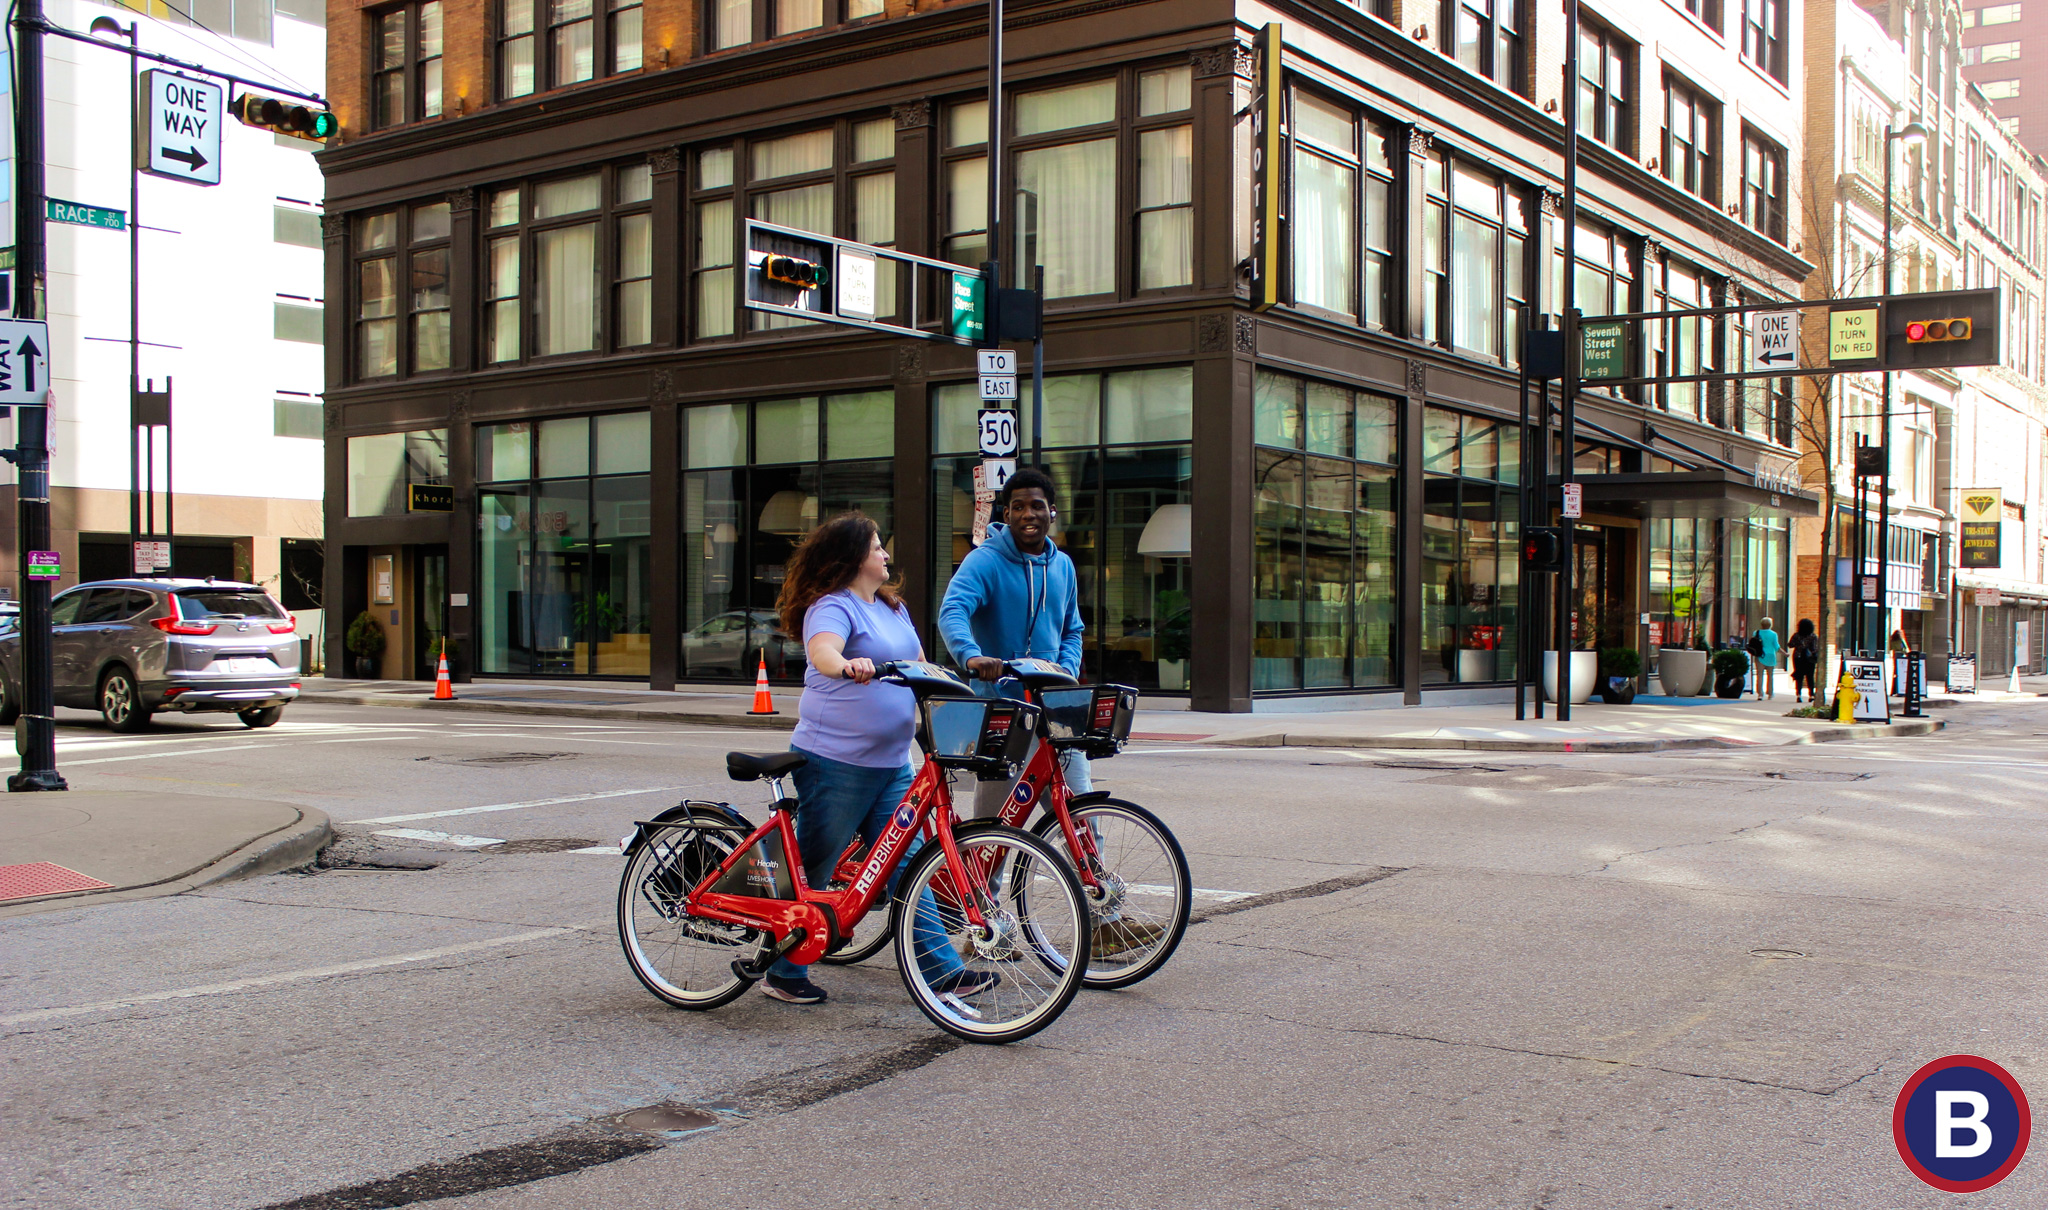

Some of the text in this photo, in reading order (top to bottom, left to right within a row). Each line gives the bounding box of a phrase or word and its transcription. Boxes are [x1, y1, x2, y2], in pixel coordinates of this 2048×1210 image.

[166, 82, 207, 113] ONE
[163, 109, 208, 139] WAY
[1253, 110, 1263, 280] HOTEL
[55, 203, 97, 224] RACE
[103, 217, 120, 228] 700
[851, 264, 864, 275] NO
[847, 277, 867, 289] TURN
[955, 282, 971, 297] Race
[842, 291, 872, 306] ON RED
[955, 296, 975, 313] Street
[1761, 316, 1789, 332] ONE
[1845, 317, 1861, 326] NO
[1585, 326, 1622, 338] Seventh
[1840, 330, 1866, 340] TURN
[1585, 337, 1616, 349] Street
[1761, 334, 1789, 349] WAY
[1834, 343, 1872, 353] ON RED
[1585, 349, 1610, 360] West
[988, 356, 1005, 369] TO
[985, 380, 1010, 395] EAST
[986, 419, 1011, 446] 50
[415, 493, 452, 504] Khora
[1965, 527, 1996, 535] TRI-STATE
[1964, 540, 1997, 548] JEWELERS
[757, 859, 779, 868] Health
[855, 826, 902, 895] REDBIKE
